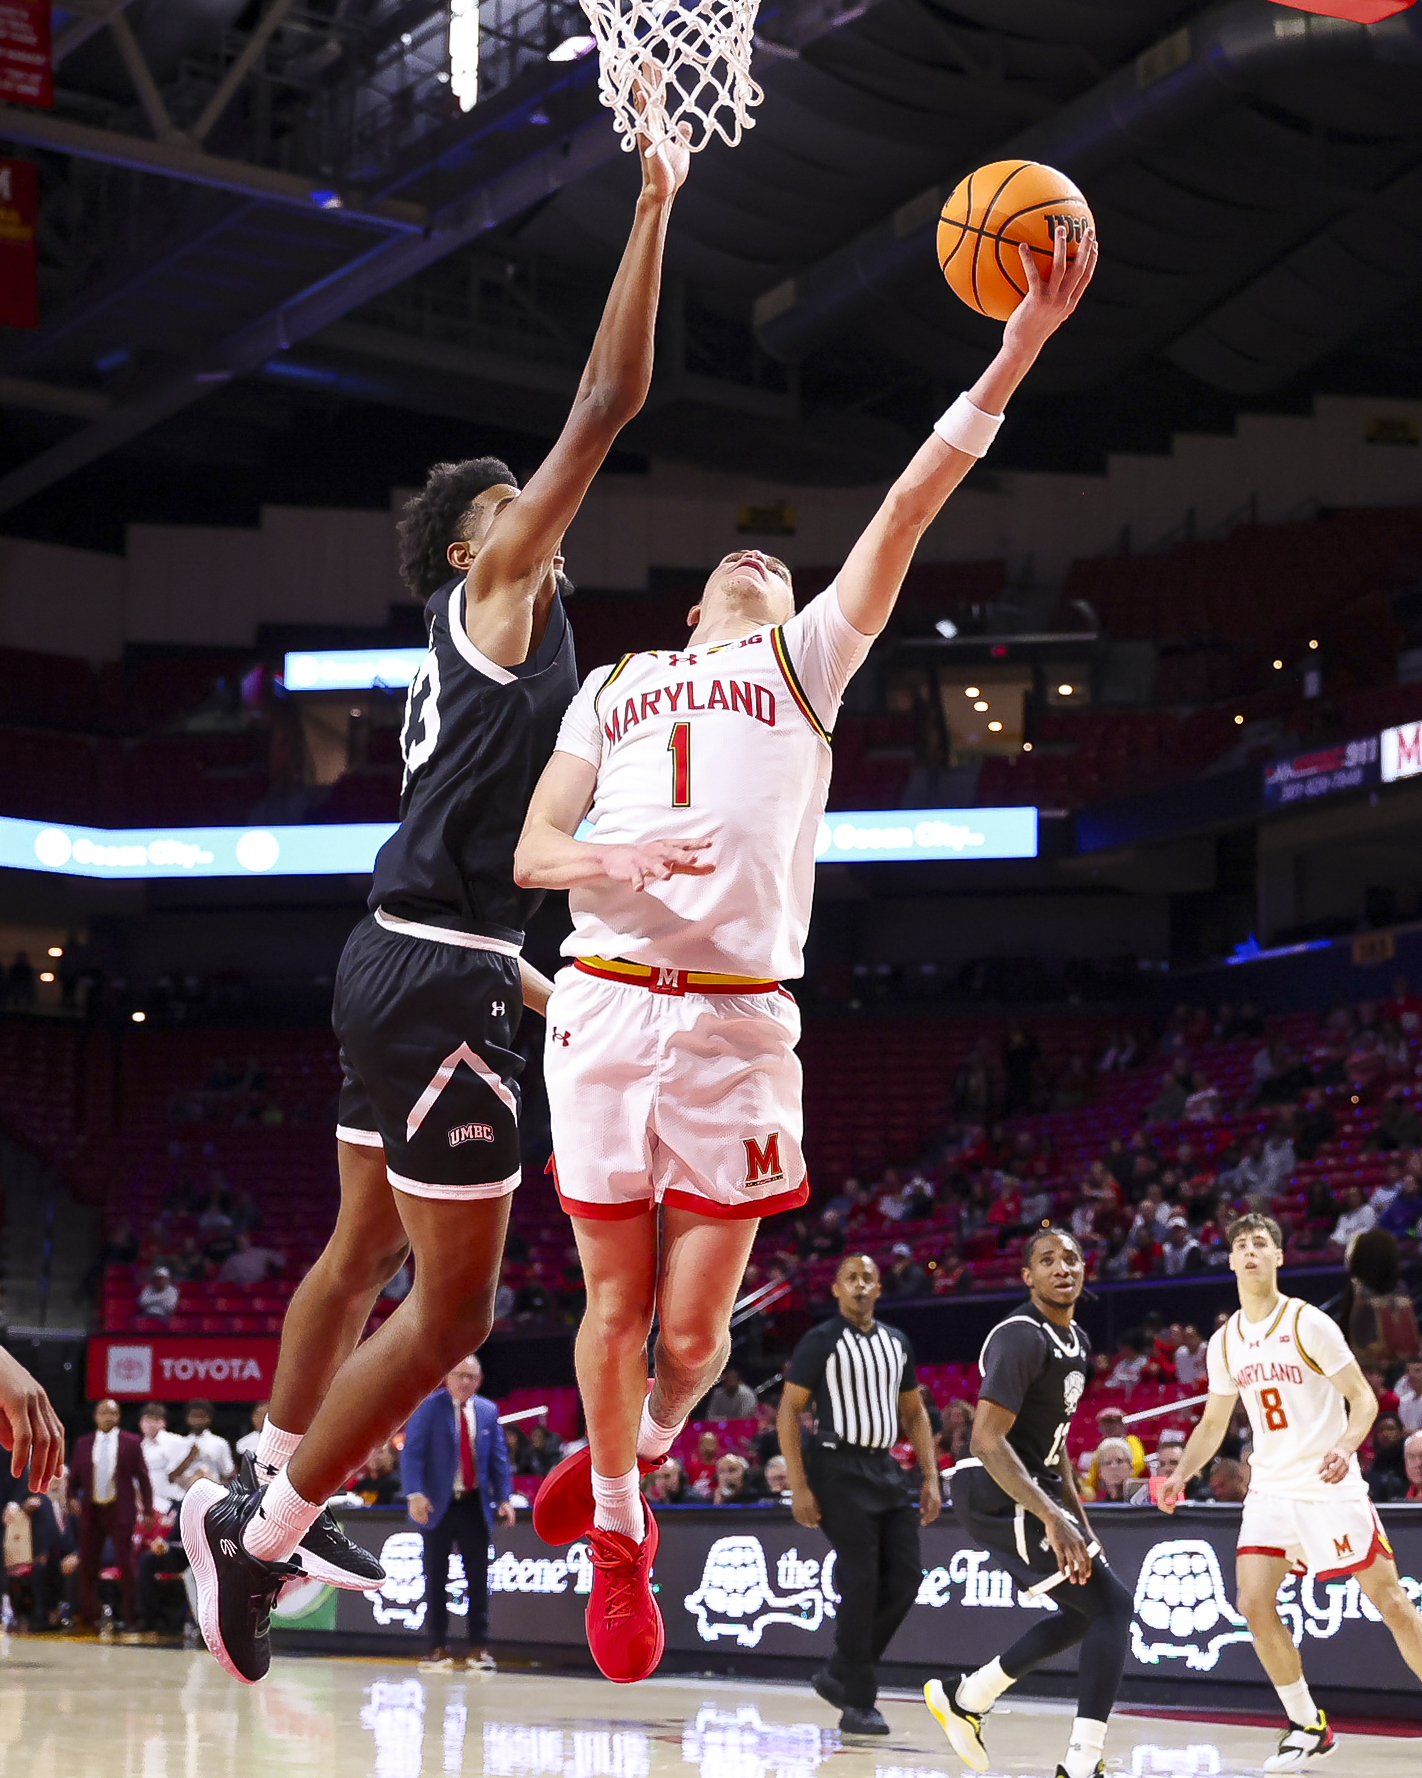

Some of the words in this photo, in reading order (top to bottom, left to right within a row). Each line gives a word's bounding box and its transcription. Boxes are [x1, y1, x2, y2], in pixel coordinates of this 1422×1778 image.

[604, 679, 776, 747] MARYLAND
[667, 721, 691, 808] 1
[656, 968, 679, 988] M
[449, 1123, 493, 1146] UMBC
[741, 1131, 784, 1181] M
[159, 1358, 262, 1380] TOYOTA
[1260, 1387, 1289, 1431] 8
[1333, 1533, 1353, 1557] M
[777, 1547, 821, 1589] the
